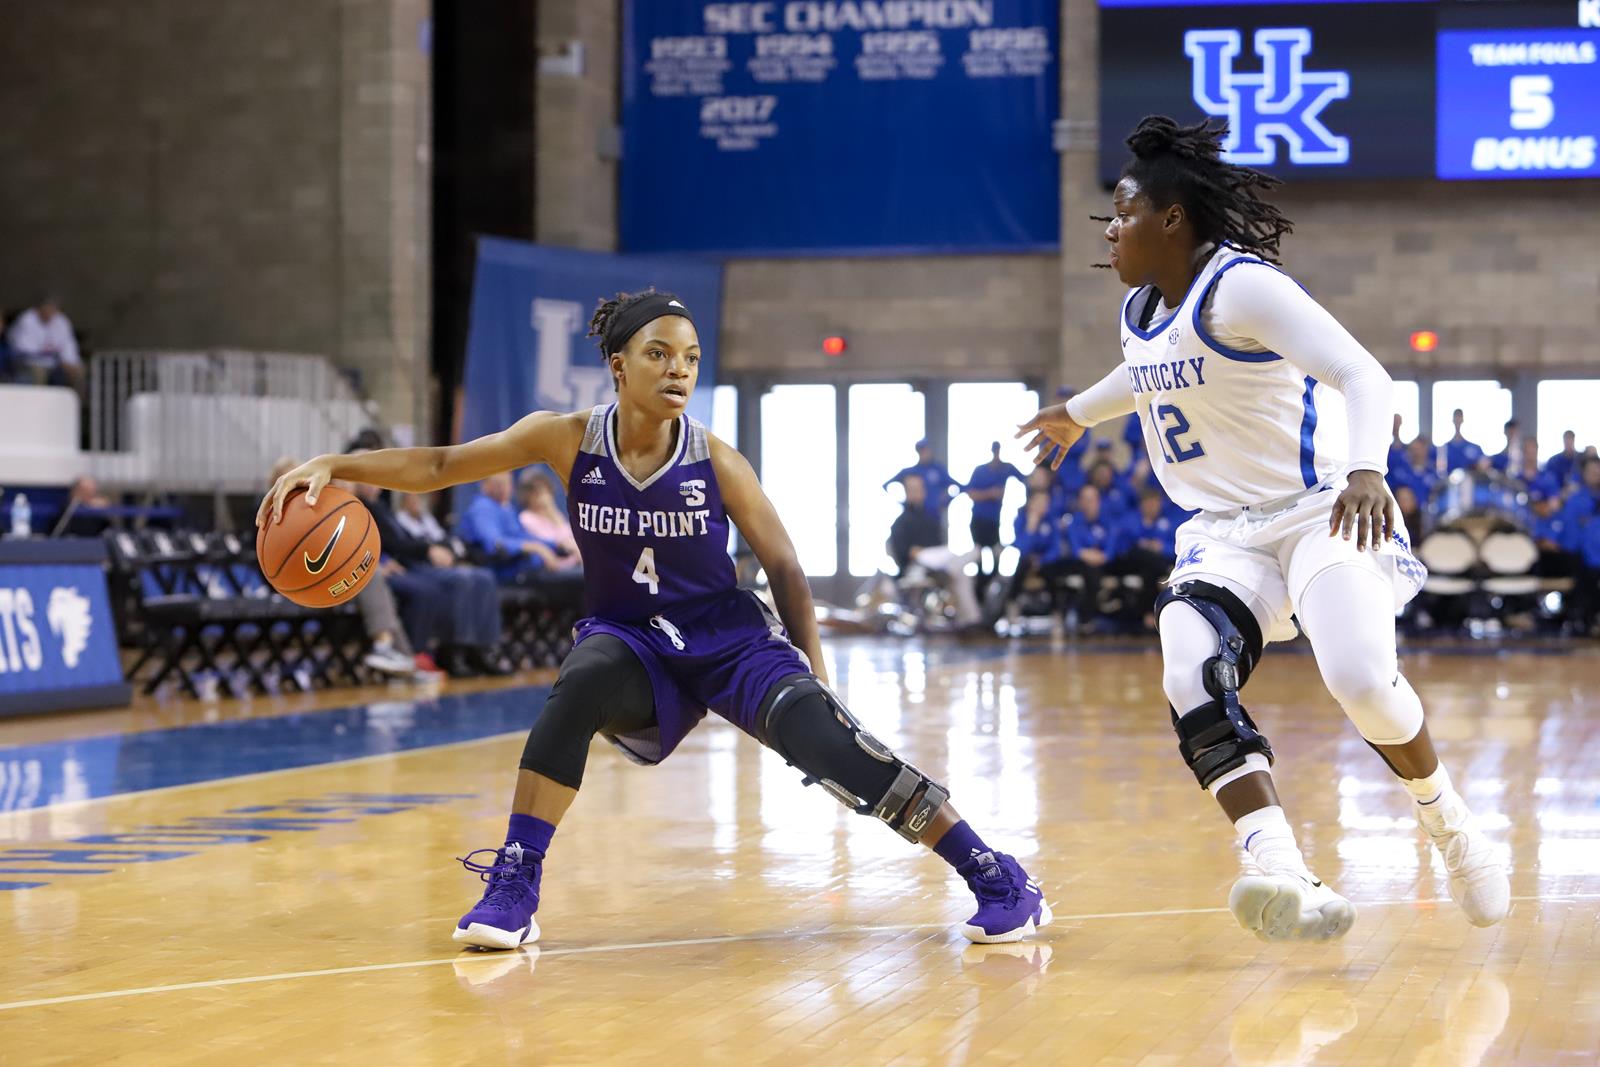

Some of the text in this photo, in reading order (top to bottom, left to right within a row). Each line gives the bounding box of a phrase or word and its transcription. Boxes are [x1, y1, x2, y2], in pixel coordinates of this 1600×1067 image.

[704, 0, 994, 33] SEC CHAMPION
[755, 34, 833, 57] 1994
[1469, 41, 1597, 66] TEAM FOULS
[701, 96, 778, 121] 2017
[1184, 28, 1350, 165] UK
[1510, 75, 1554, 129] 5
[1471, 136, 1597, 170] BONUS
[1128, 357, 1205, 393] ENTUCKY
[1149, 403, 1206, 463] 12
[581, 476, 606, 485] adidas
[578, 502, 710, 538] HIGH POINT
[328, 550, 375, 597] ELITE
[632, 547, 660, 595] 4
[0, 587, 42, 673] TS
